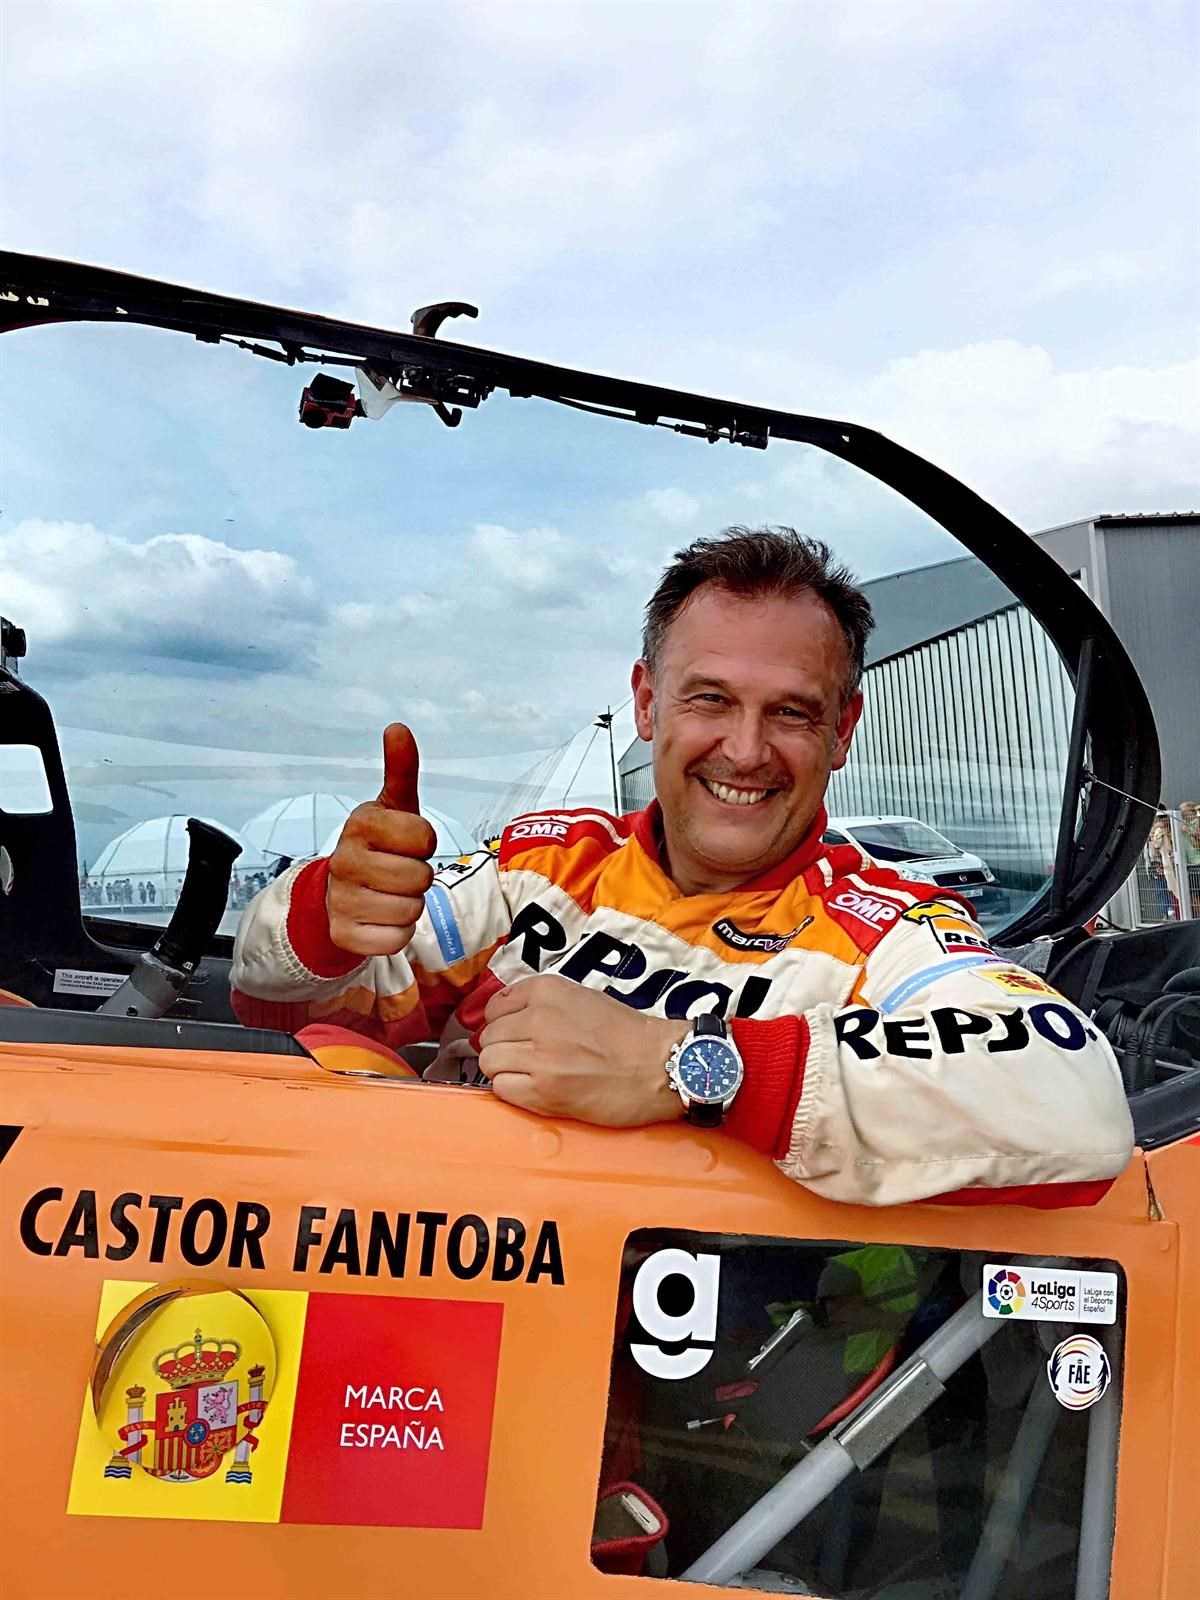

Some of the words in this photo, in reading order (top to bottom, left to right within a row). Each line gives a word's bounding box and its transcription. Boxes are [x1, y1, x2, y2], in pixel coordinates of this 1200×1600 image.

[511, 824, 568, 838] OMP
[835, 893, 897, 923] OMP
[19, 1187, 271, 1270] CASTOR
[292, 1206, 565, 1285] FANTOBA
[1031, 1281, 1076, 1298] LaLiga
[1084, 1288, 1102, 1298] LaLiga
[1031, 1297, 1075, 1312] 4Sports
[1091, 1296, 1114, 1305] Deporte
[1068, 1364, 1091, 1384] FAE
[344, 1384, 444, 1412] MARCA
[339, 1421, 444, 1450] ESPAÑA
